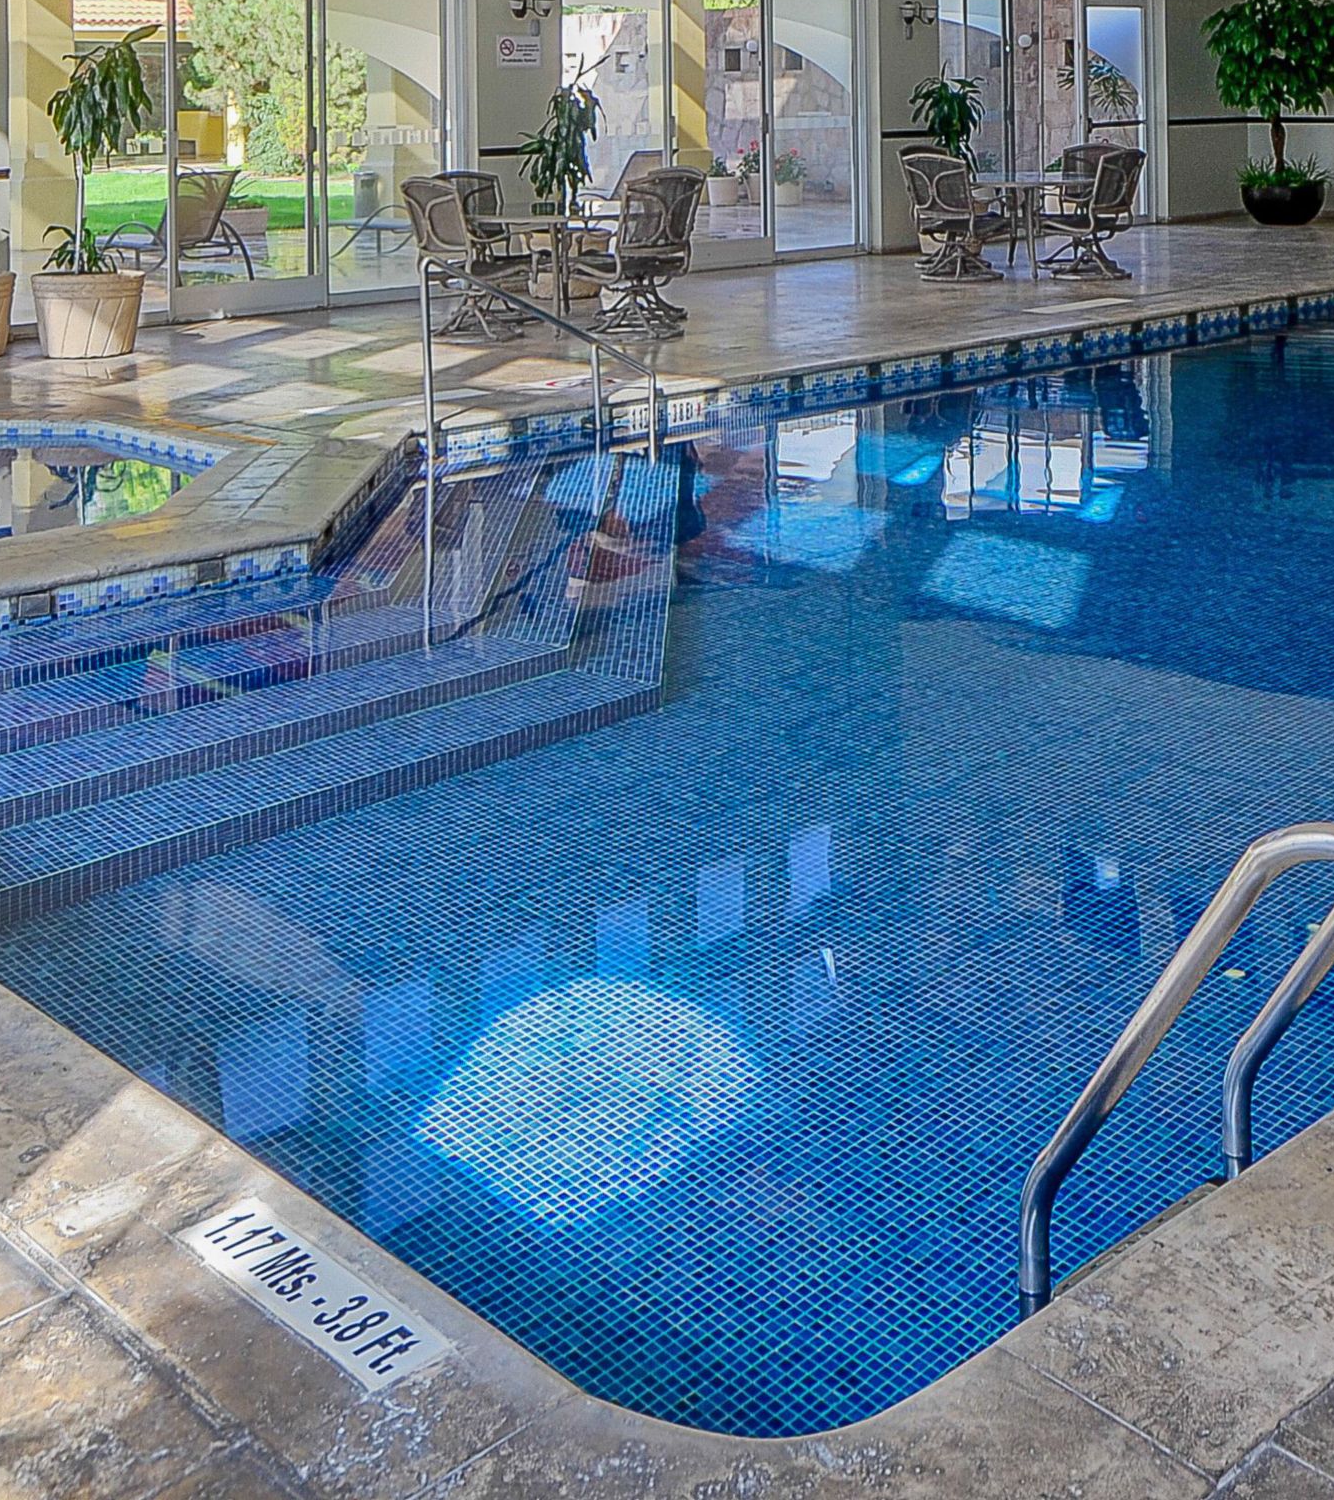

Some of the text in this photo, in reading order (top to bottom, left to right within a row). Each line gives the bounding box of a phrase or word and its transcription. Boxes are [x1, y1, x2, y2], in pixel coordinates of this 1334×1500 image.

[204, 1212, 283, 1260] 1.17
[248, 1247, 317, 1303] Mts.
[312, 1294, 390, 1343] 3.8
